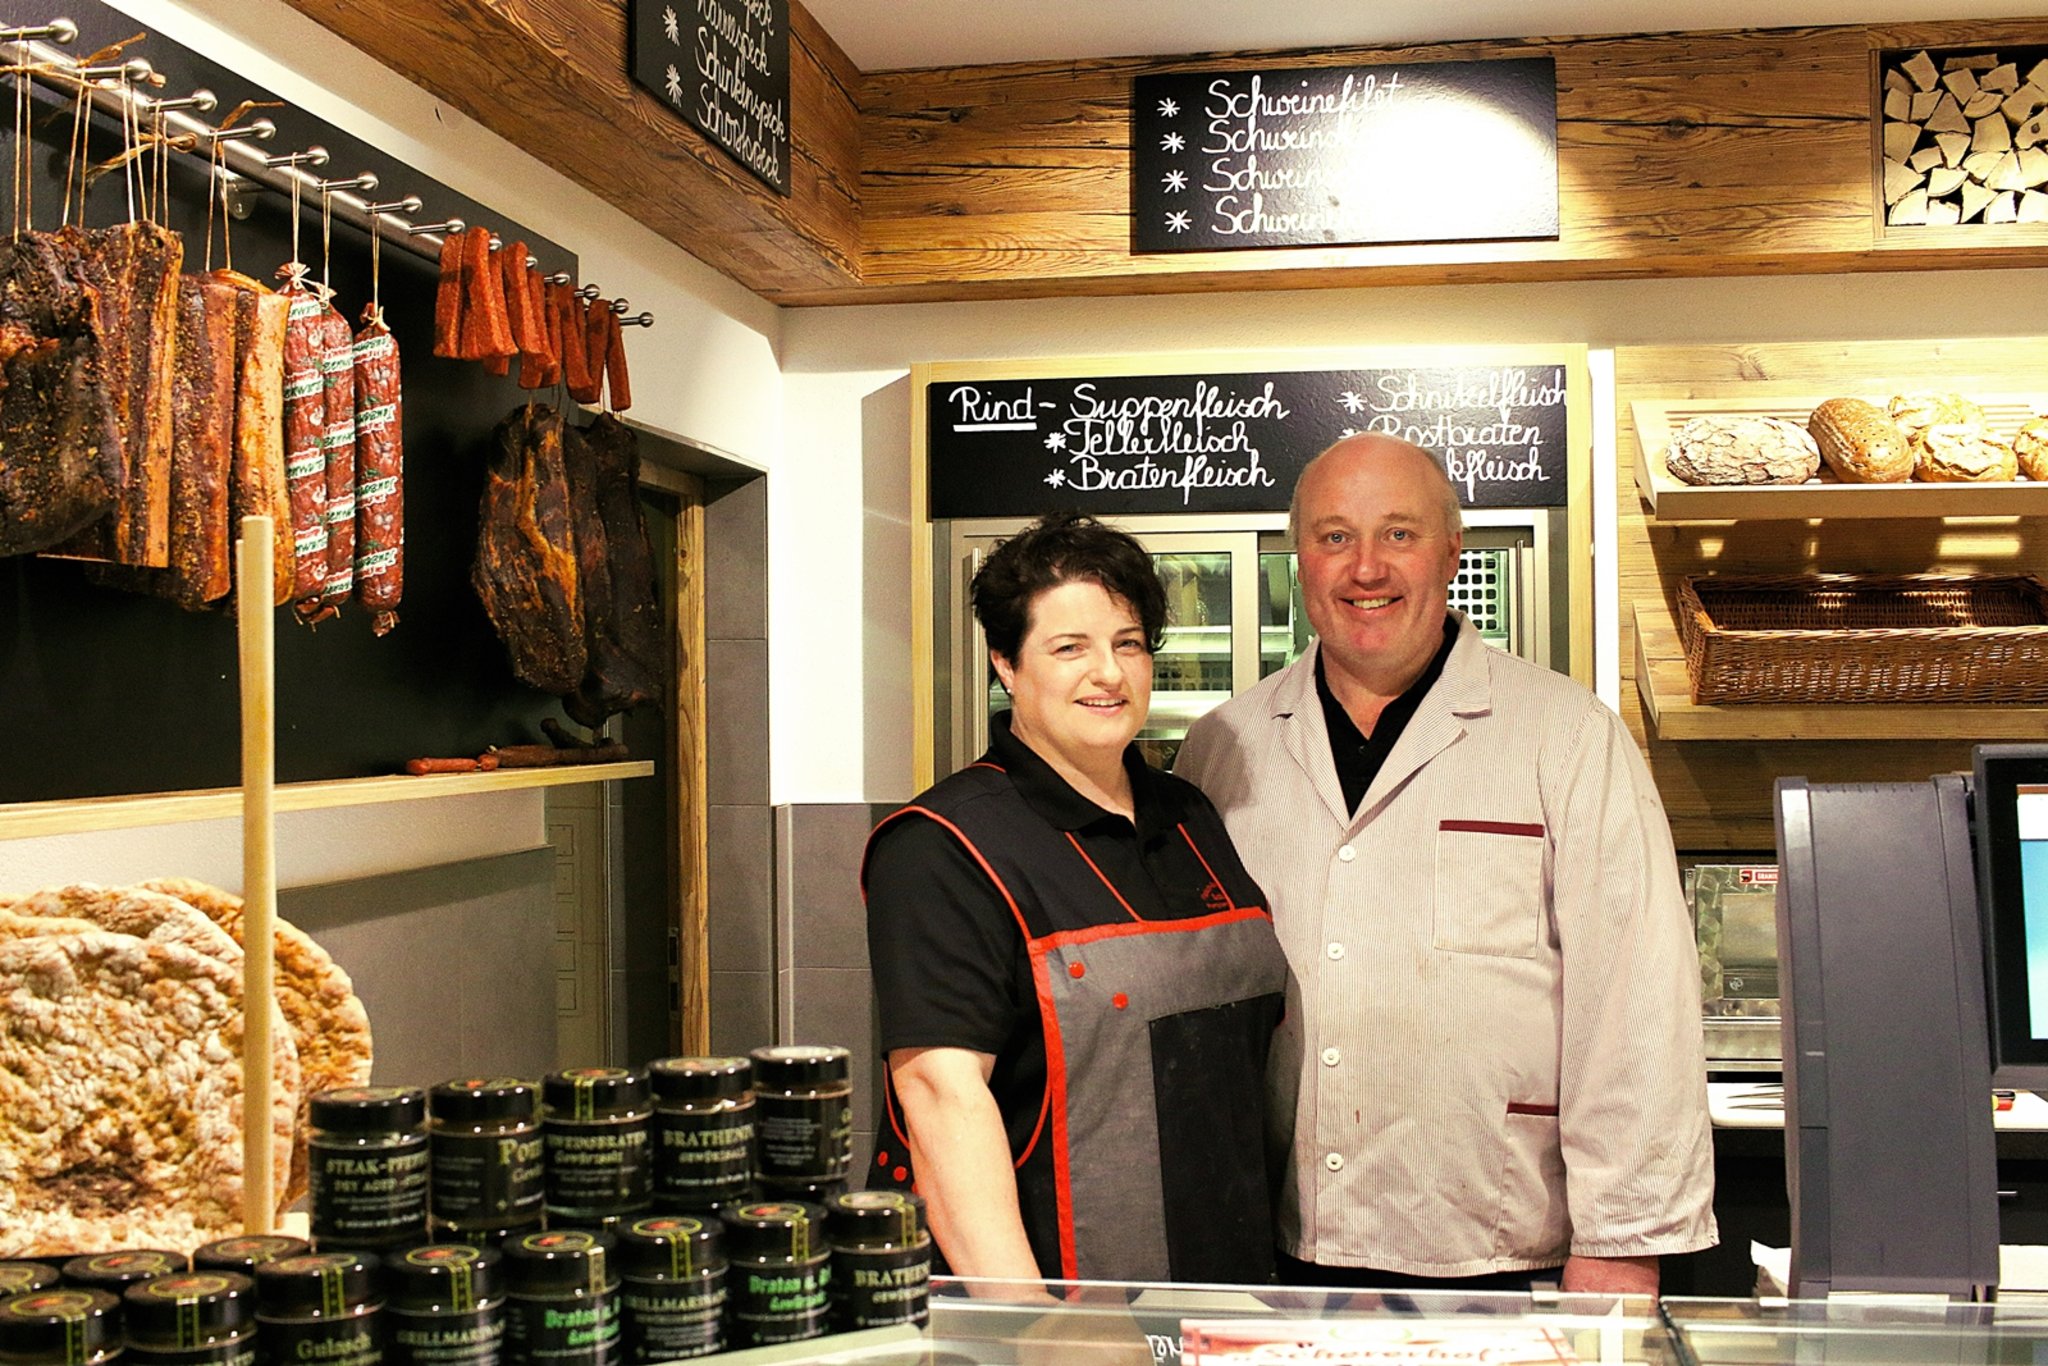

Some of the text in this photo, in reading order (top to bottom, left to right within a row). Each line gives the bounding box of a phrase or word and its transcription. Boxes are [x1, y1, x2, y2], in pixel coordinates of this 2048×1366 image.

[1205, 72, 1404, 119] Schweinefilet
[1070, 380, 1290, 432] Suppenfleisch
[1067, 449, 1276, 505] Bratenfleisch
[1446, 446, 1551, 502] kfleisch
